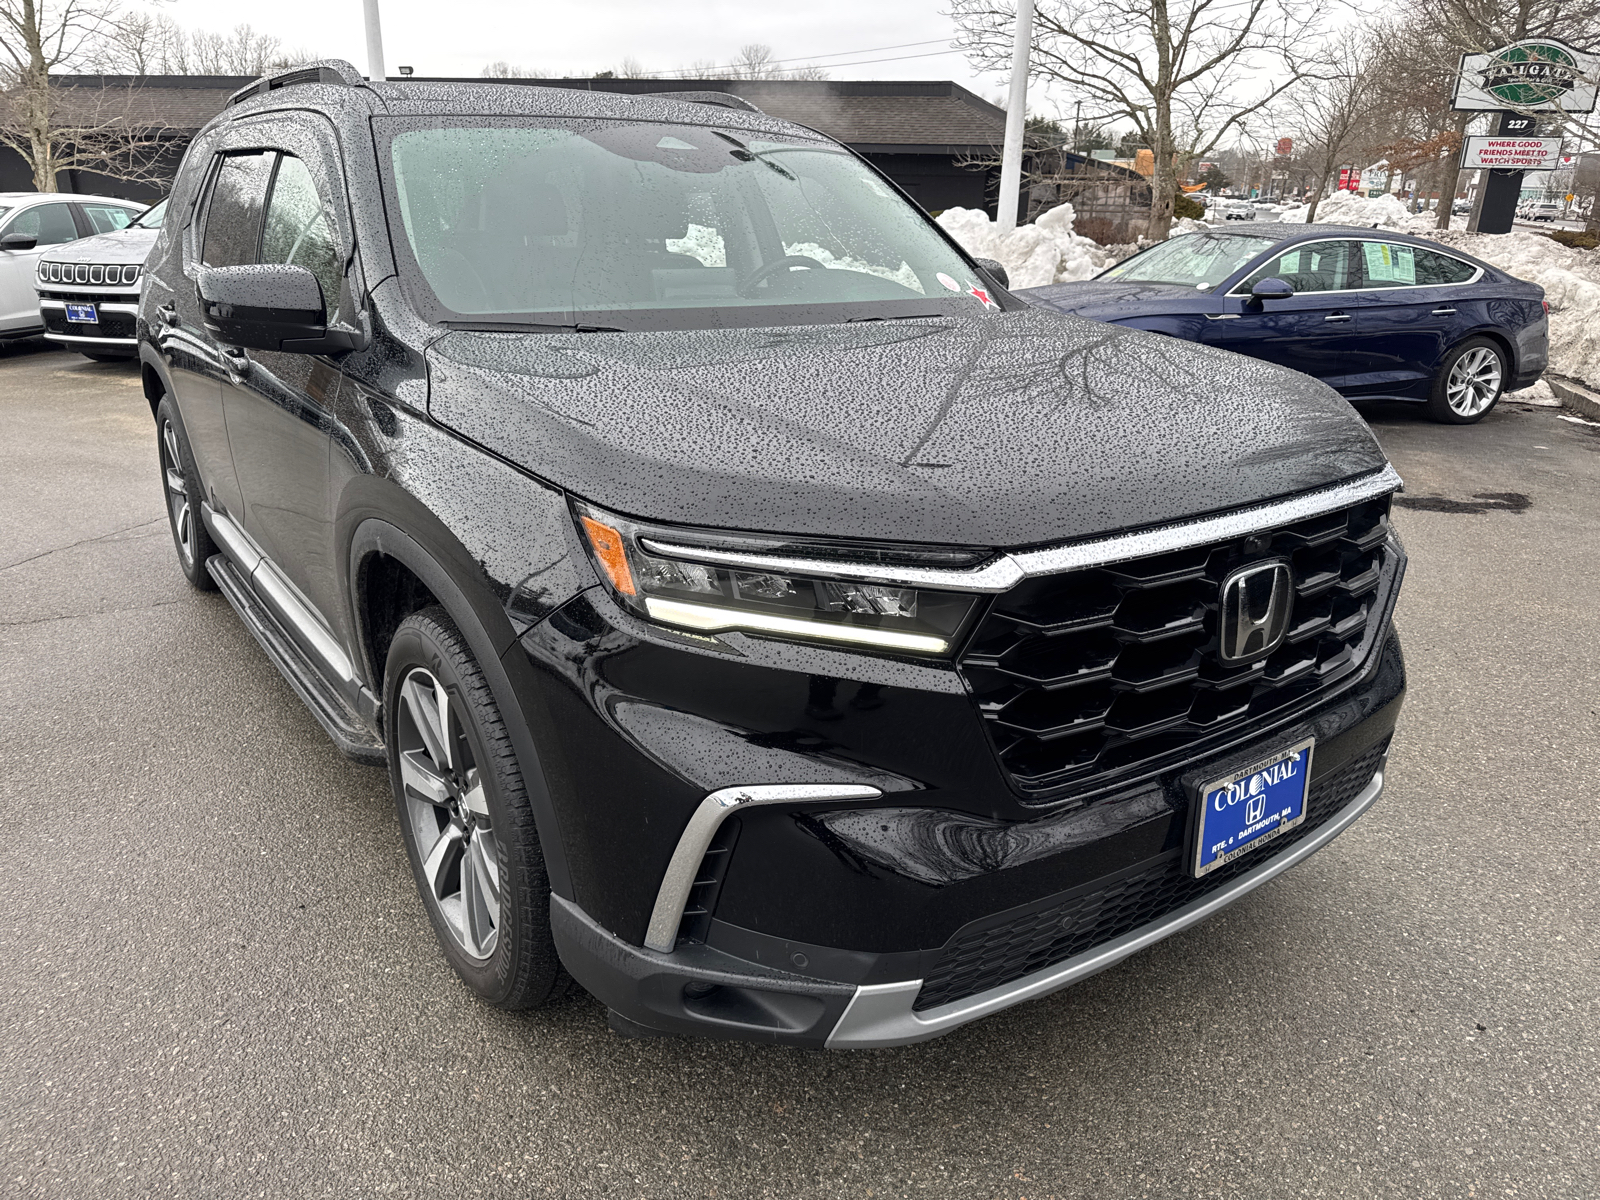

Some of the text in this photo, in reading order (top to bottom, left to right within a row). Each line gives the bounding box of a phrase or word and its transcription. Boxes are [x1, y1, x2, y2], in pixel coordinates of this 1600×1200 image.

[1507, 120, 1528, 129] 227
[1214, 760, 1298, 812] COLONIAL
[1211, 806, 1292, 854] RTE. 6 DARTMOUTH, MA
[1223, 828, 1281, 863] COLONIAL HONDA
[498, 840, 513, 985] BRIDGESTONE
